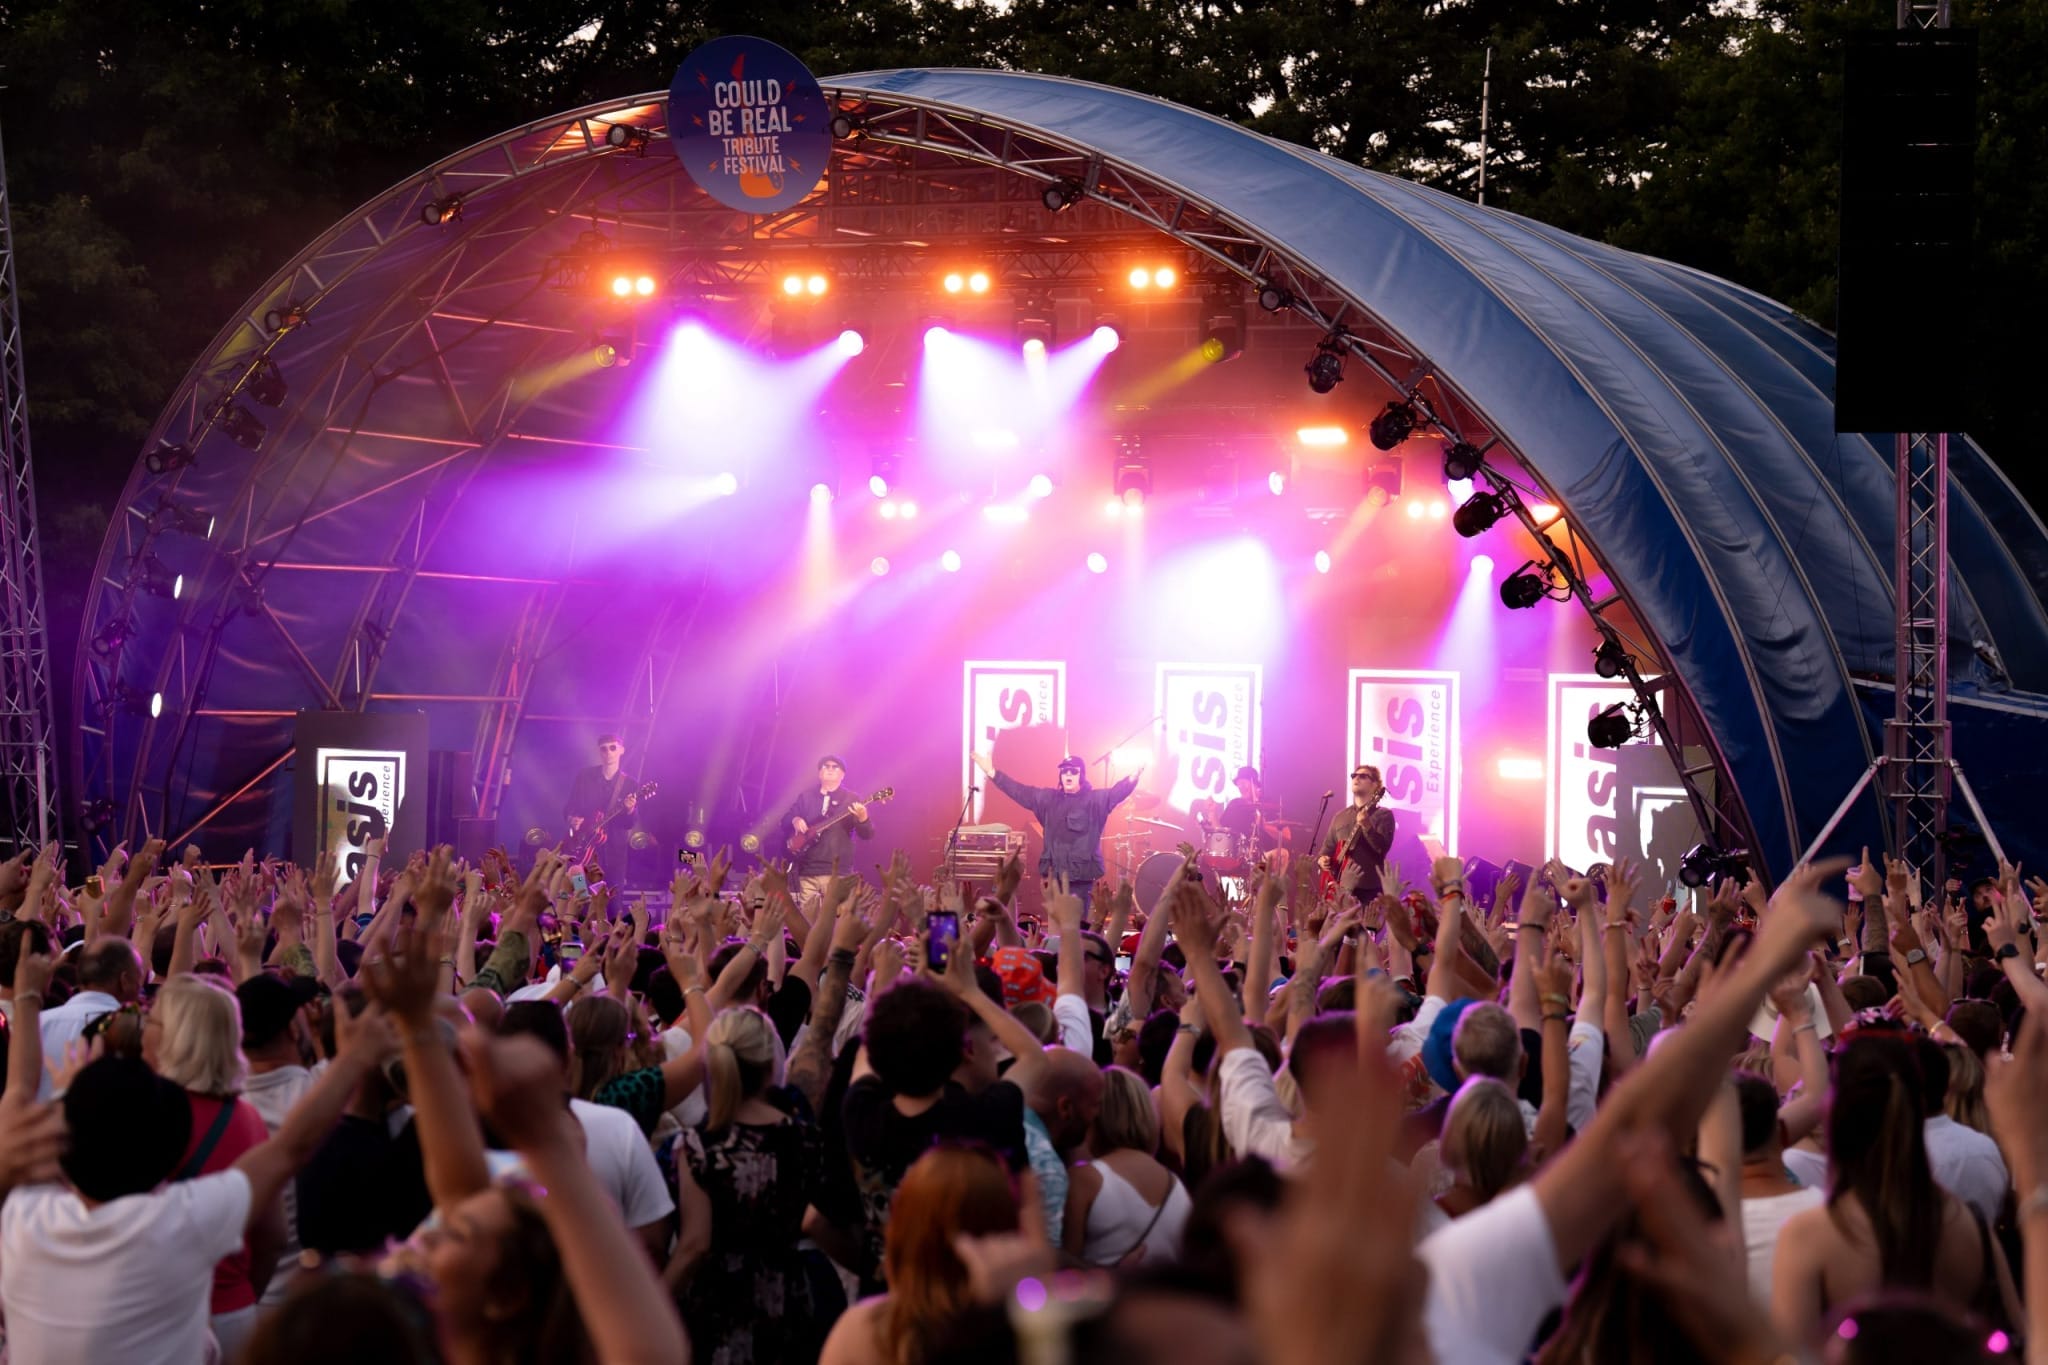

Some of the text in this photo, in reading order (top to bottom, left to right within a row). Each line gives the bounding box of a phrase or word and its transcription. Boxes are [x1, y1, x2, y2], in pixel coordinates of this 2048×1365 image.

[714, 79, 781, 109] COULD
[708, 106, 793, 136] BE REAL
[722, 136, 780, 155] TRIBUTE
[723, 155, 786, 175] FESTIVAL
[1426, 688, 1442, 792] Experience
